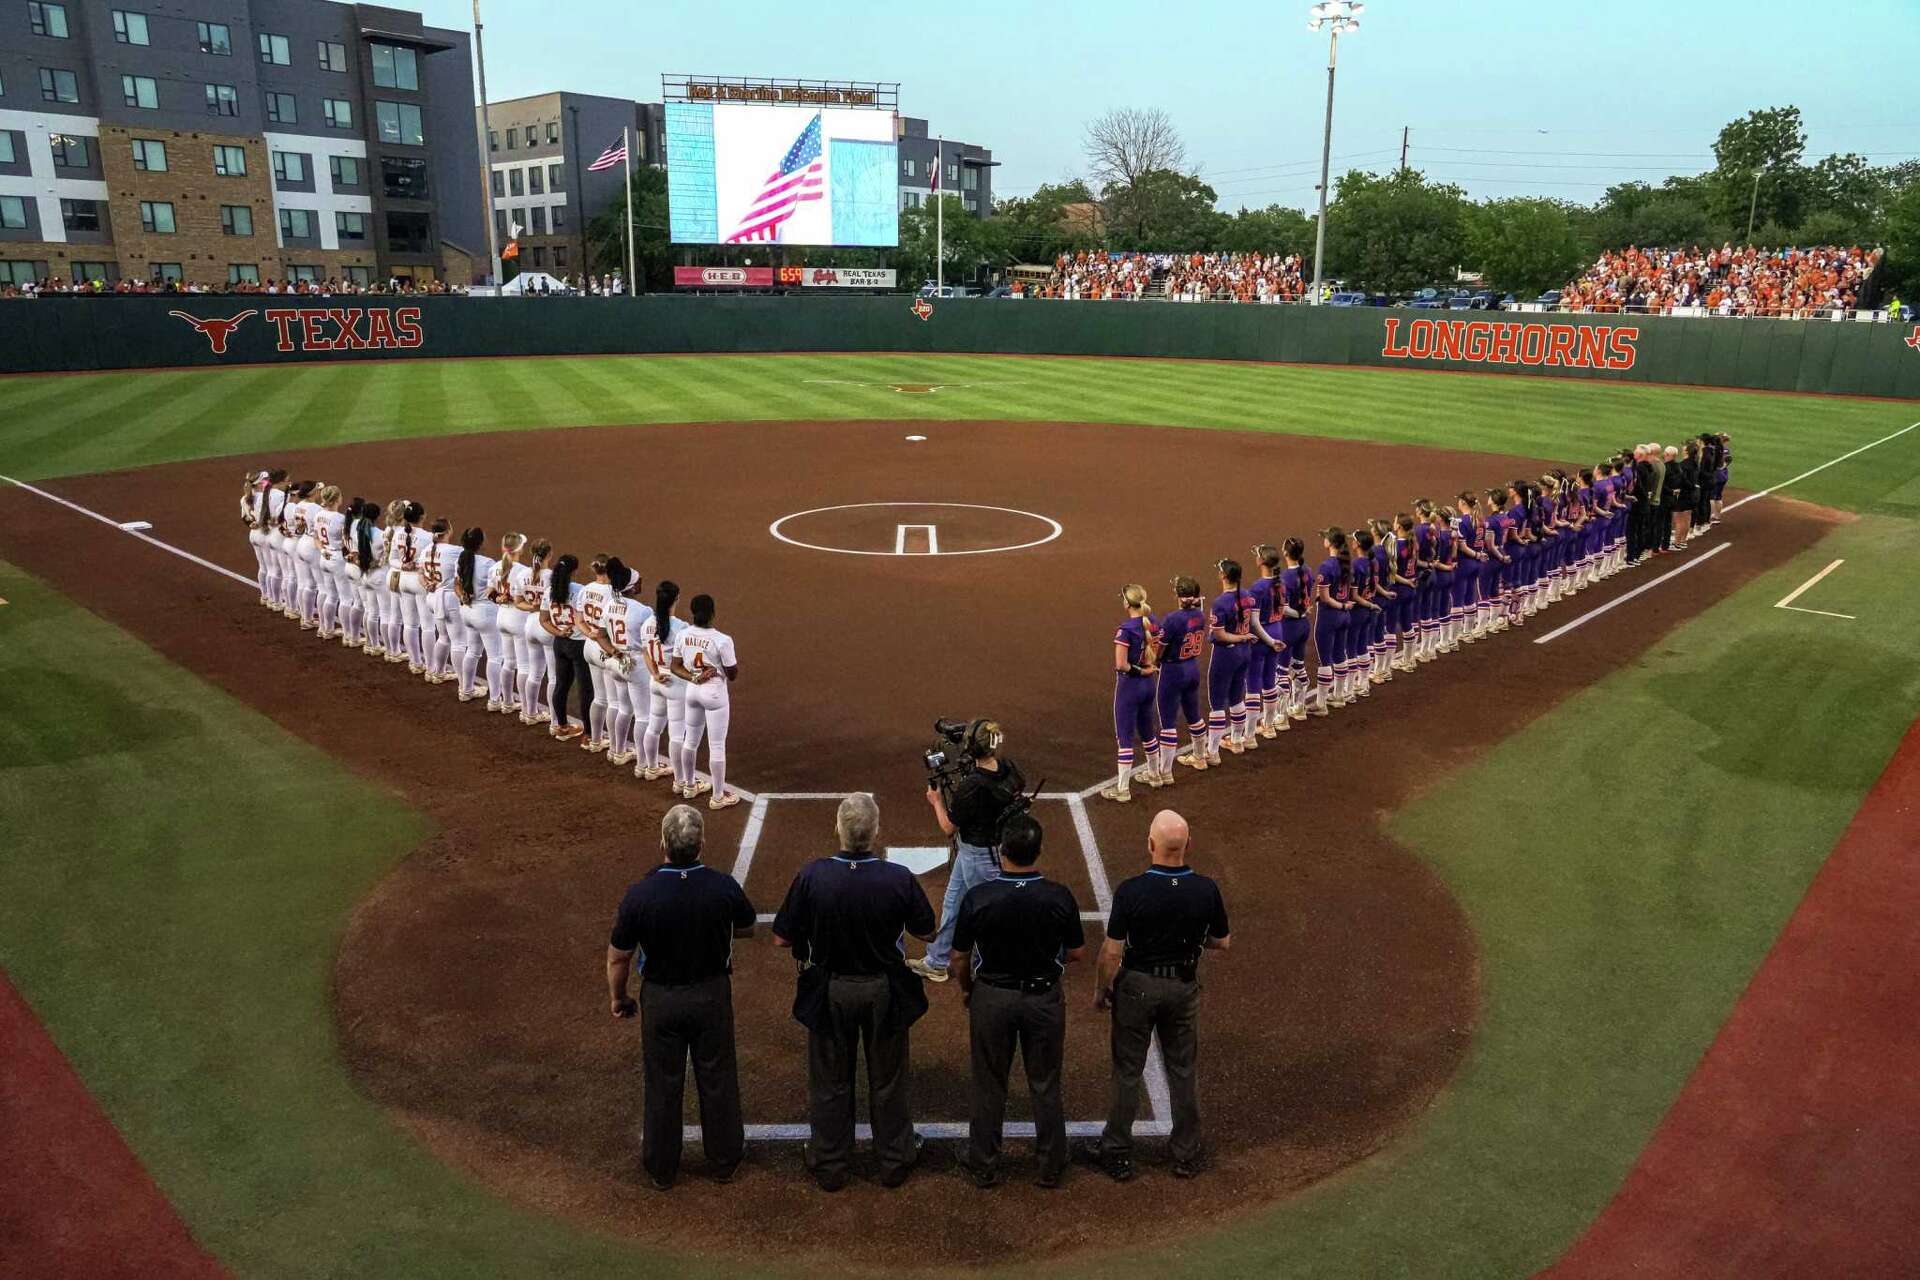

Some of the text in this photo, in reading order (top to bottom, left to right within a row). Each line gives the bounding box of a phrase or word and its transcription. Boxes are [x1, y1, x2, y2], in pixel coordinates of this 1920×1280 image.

[843, 270, 861, 278] REAL
[265, 308, 424, 351] TEXAS
[1382, 318, 1639, 369] LONGHORNS
[609, 618, 627, 645] 12
[693, 652, 704, 669] 4
